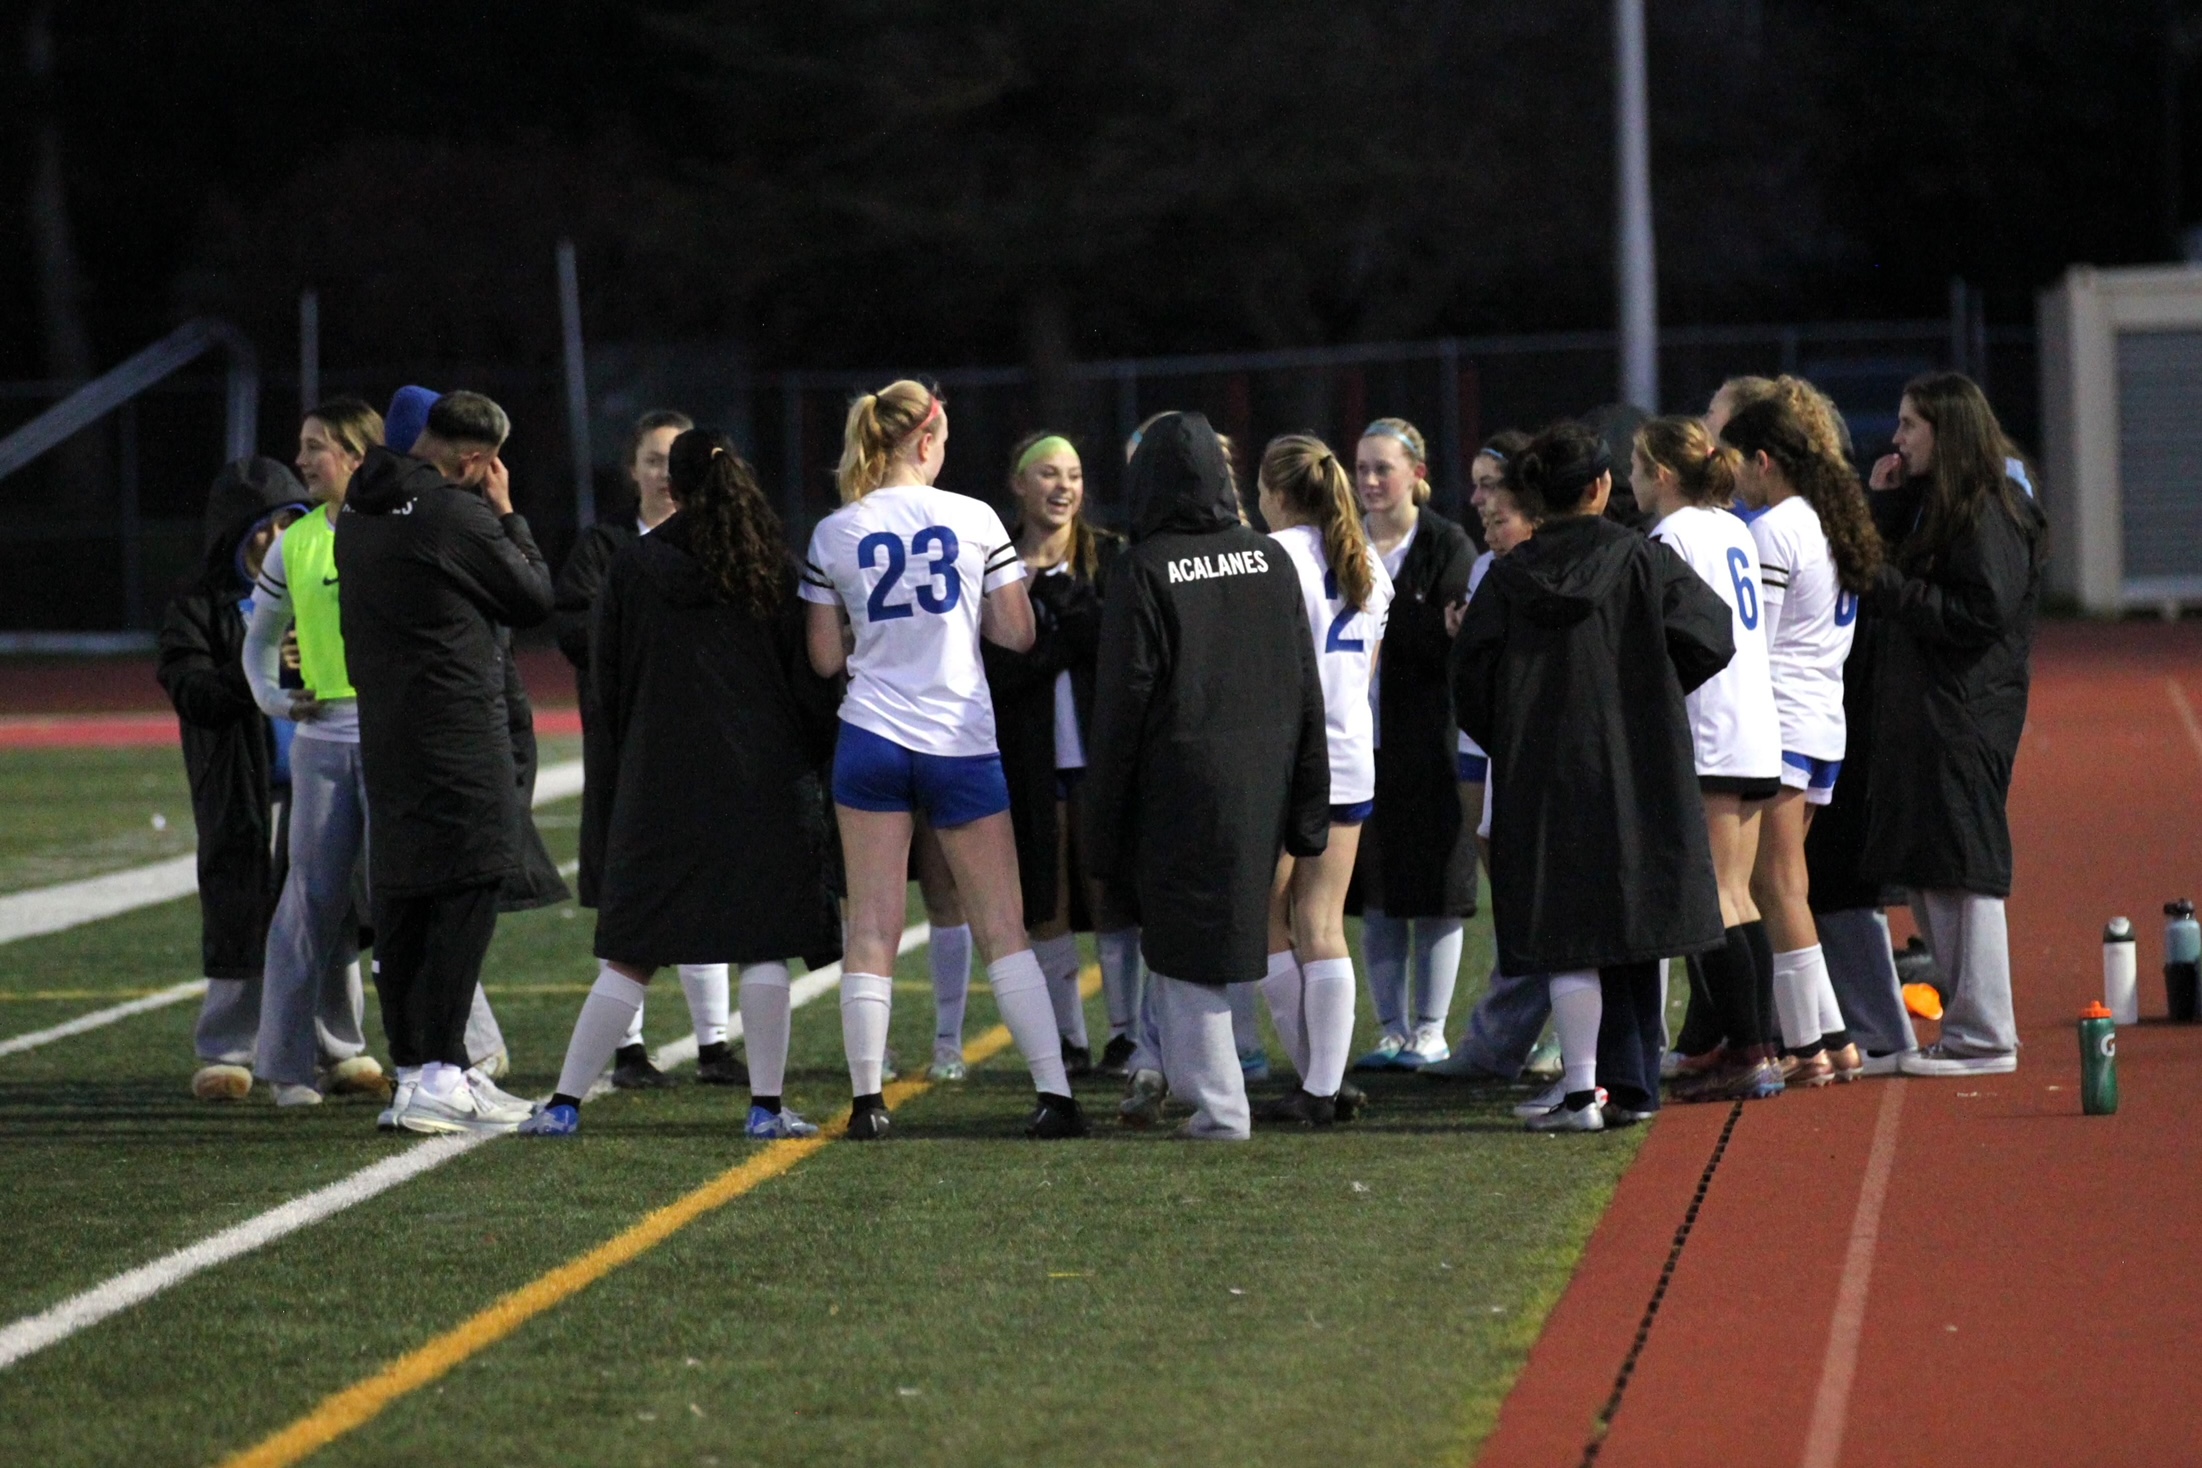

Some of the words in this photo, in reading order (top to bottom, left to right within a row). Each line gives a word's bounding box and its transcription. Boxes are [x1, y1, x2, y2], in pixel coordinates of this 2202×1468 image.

[857, 525, 961, 623] 23
[1167, 550, 1269, 583] ACALANES
[1726, 546, 1759, 631] 6
